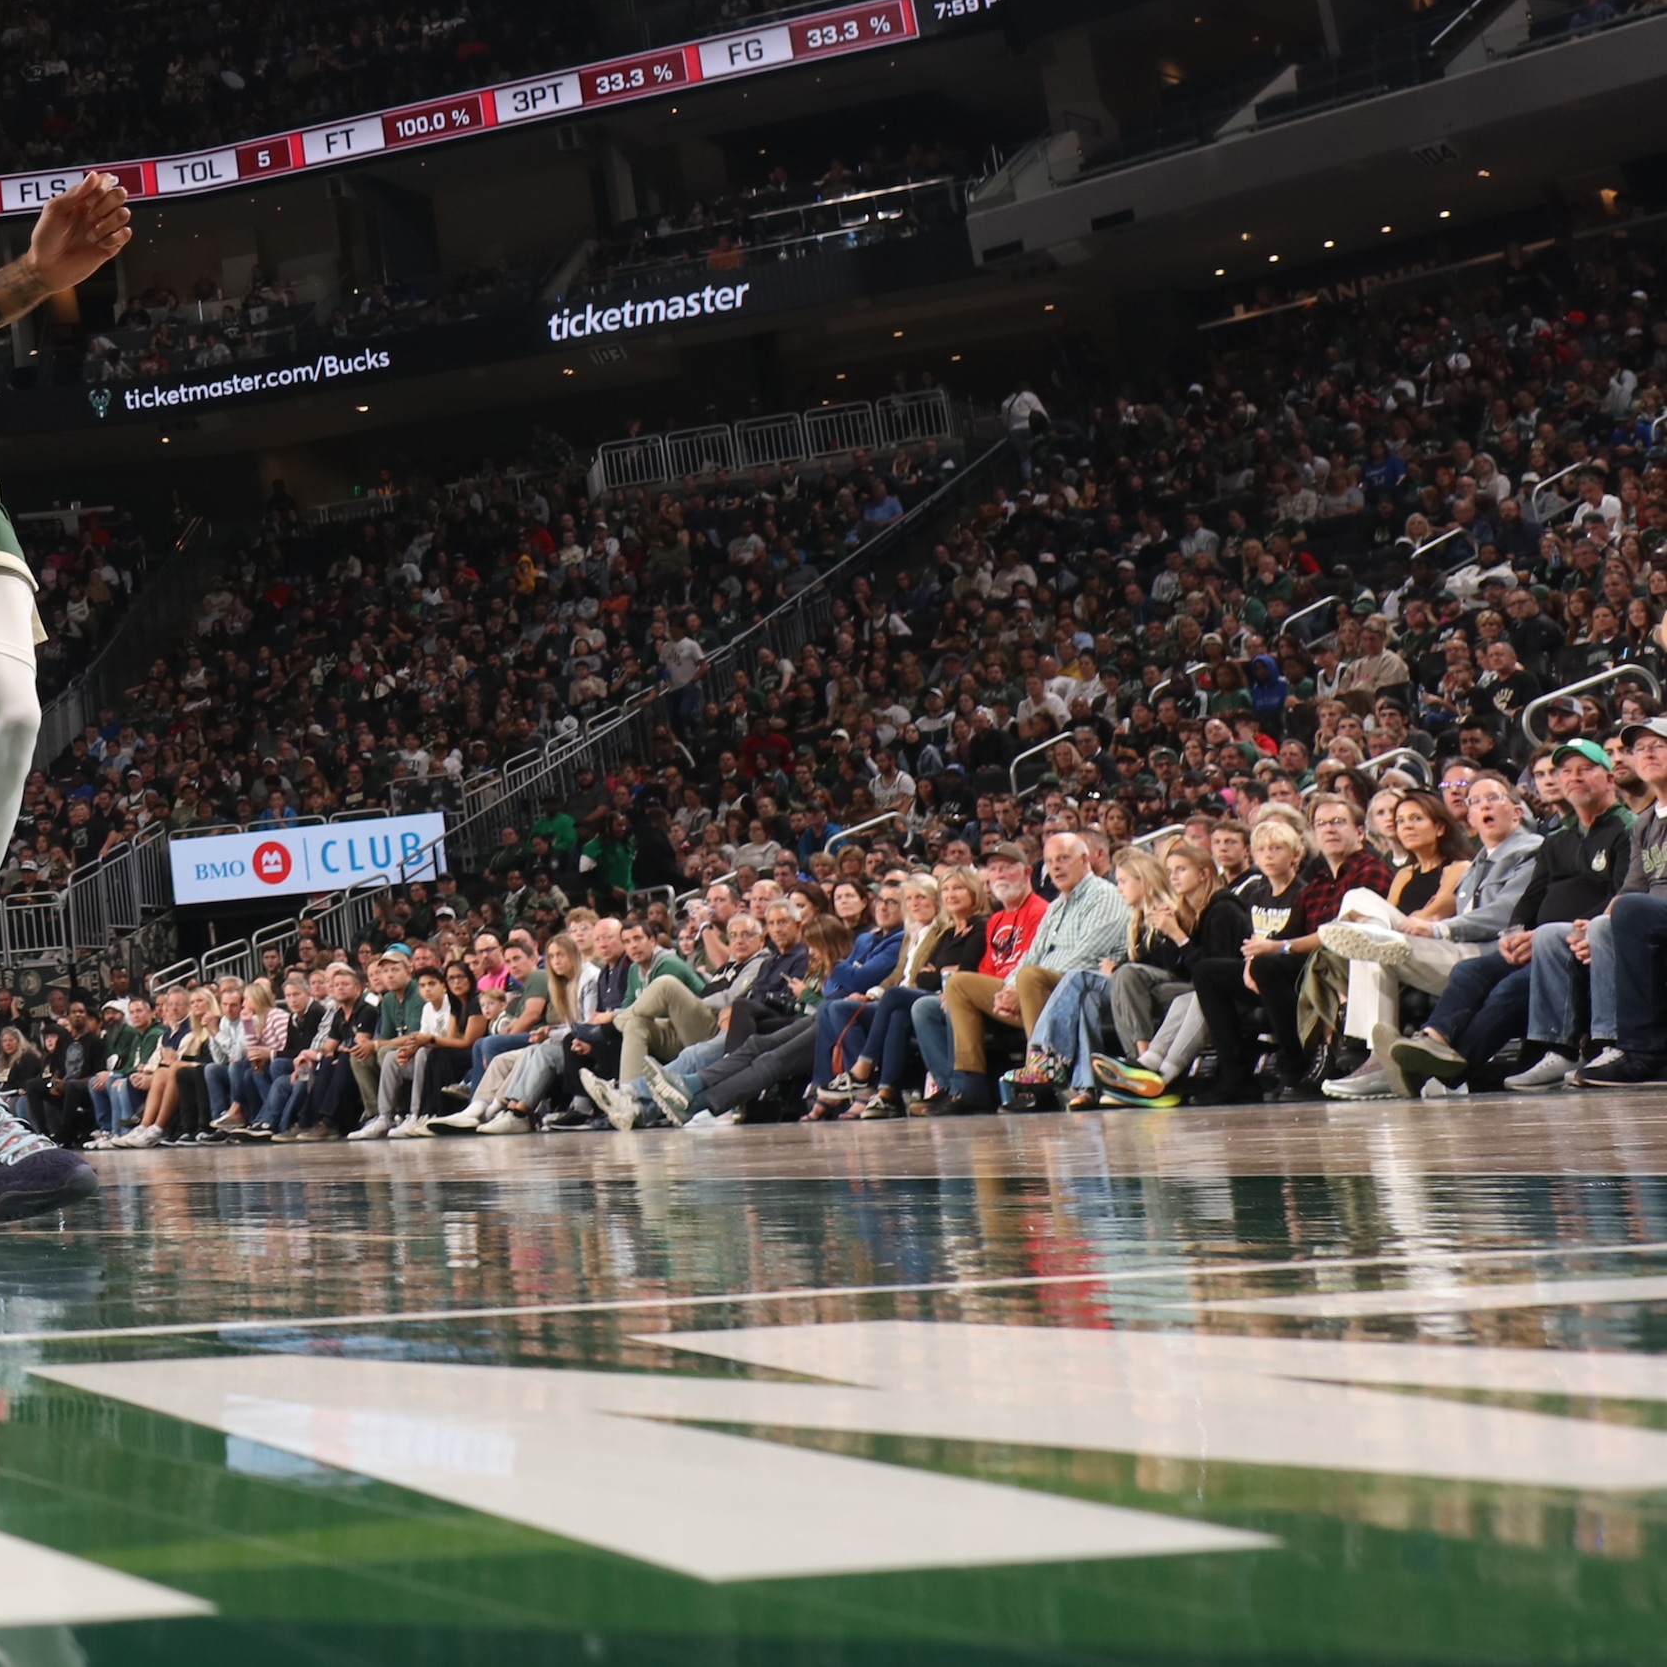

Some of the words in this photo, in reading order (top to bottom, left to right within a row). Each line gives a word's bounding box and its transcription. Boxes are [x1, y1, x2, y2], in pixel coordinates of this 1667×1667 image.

[19, 178, 67, 204] FLS
[174, 160, 223, 186] TOL
[257, 150, 271, 168] 5
[325, 129, 356, 154] FT
[395, 113, 445, 139] 100.0
[451, 108, 471, 127] %
[513, 83, 564, 114] 3PT
[595, 69, 645, 96] 33.3
[653, 63, 673, 84] %
[728, 39, 764, 66] FG
[807, 22, 859, 48] 33.3
[870, 15, 891, 36] %
[548, 281, 750, 342] ticketmaster
[124, 346, 390, 411] ticketmaster.com/Bucks
[195, 860, 245, 881] BMO
[320, 831, 426, 874] CLUB
